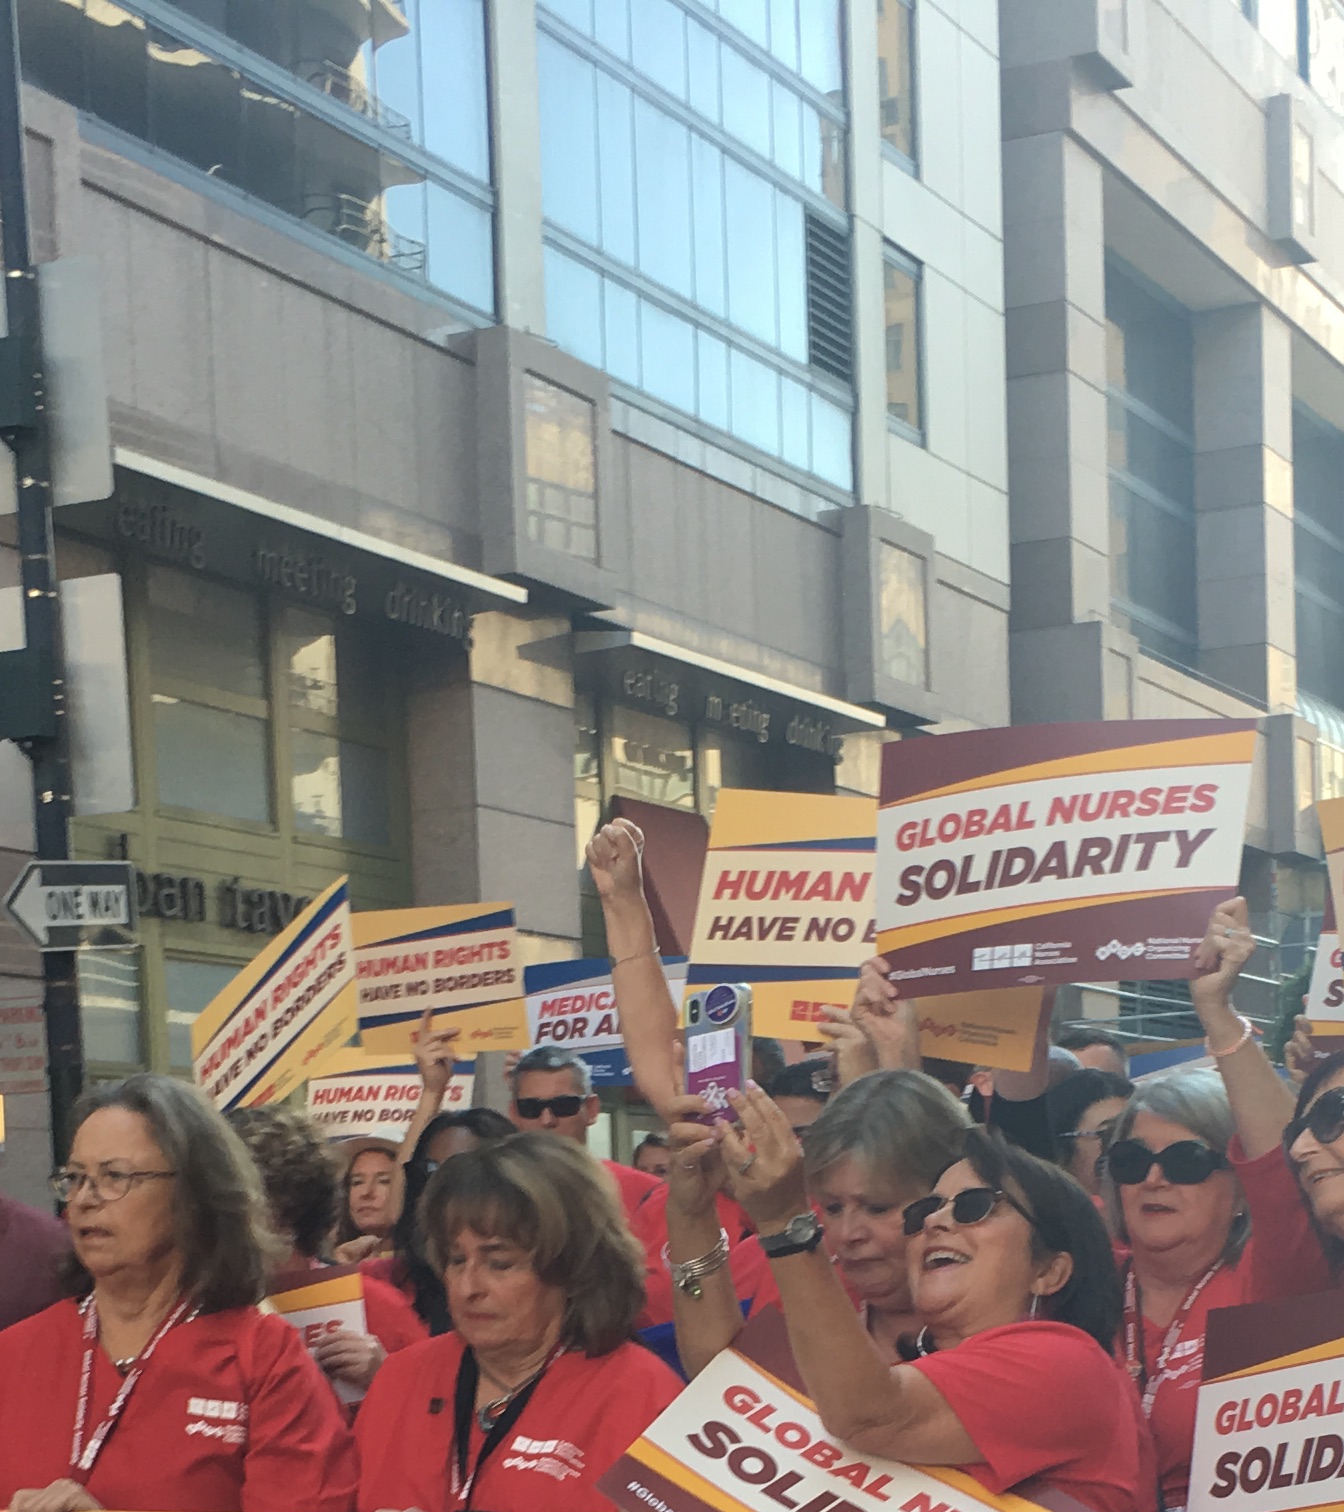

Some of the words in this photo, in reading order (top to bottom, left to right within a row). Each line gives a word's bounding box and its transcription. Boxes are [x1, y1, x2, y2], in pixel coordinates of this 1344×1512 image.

[895, 800, 1036, 852] GLOBAL
[1045, 783, 1221, 828] NURSES
[894, 827, 1217, 907] SOLIDARITY
[45, 890, 84, 920] ONE
[87, 889, 125, 920] WAY
[712, 871, 871, 902] HUMAN
[707, 916, 801, 942] HAVE
[805, 917, 855, 943] NO
[357, 950, 430, 980] HUMAN
[433, 939, 511, 970] RIGHTS
[200, 1002, 267, 1082] HUMAN
[272, 922, 343, 1008] RIGHTS
[270, 952, 347, 1039] BORDERS
[360, 983, 401, 1003] HAVE
[406, 979, 430, 998] NO
[432, 967, 516, 992] BORDERS
[535, 1017, 589, 1045] FOR
[312, 1086, 382, 1105] HUMAN
[352, 1108, 374, 1123] NO
[722, 1384, 894, 1502] GLOBAL
